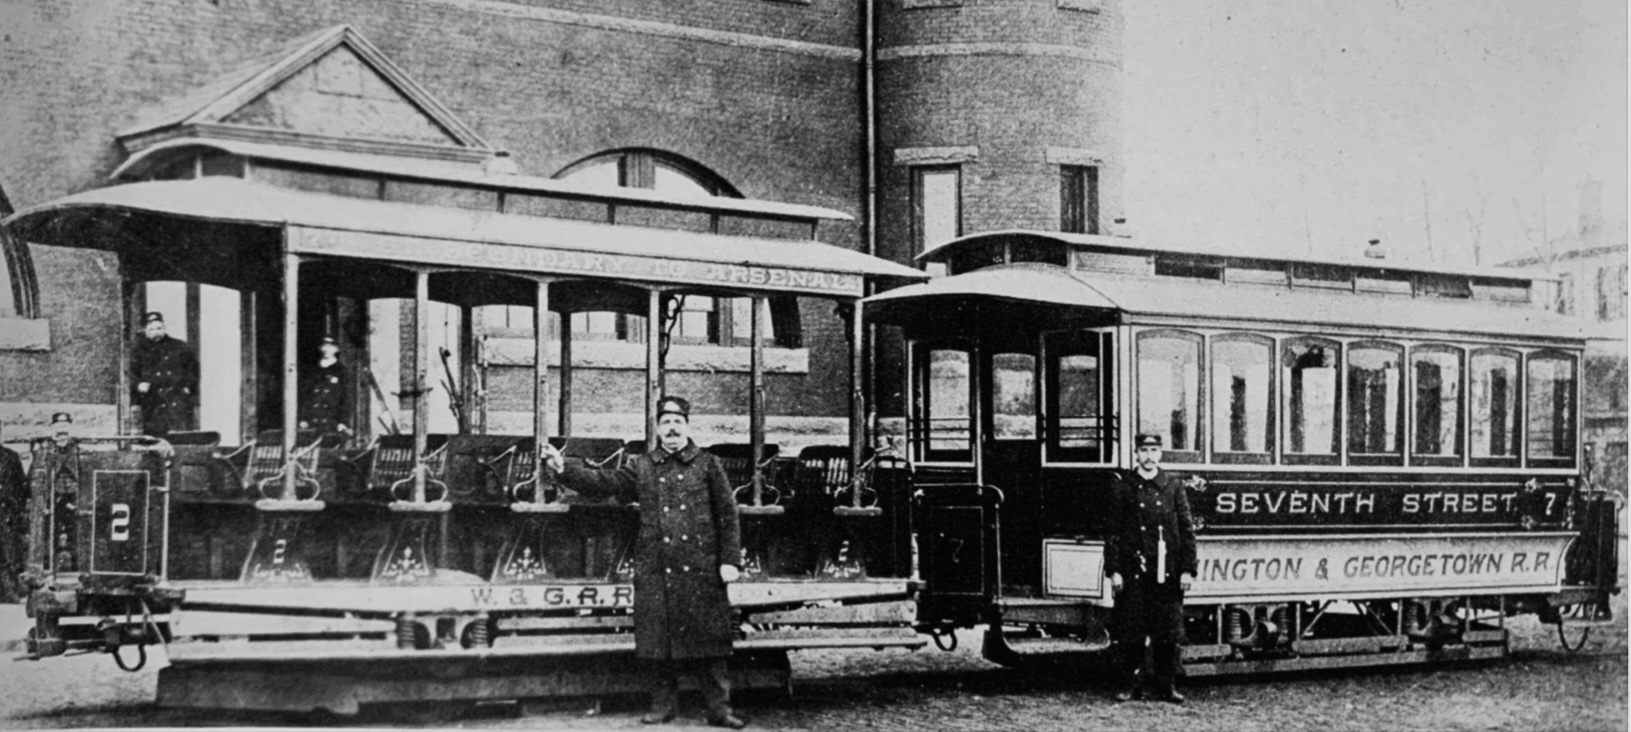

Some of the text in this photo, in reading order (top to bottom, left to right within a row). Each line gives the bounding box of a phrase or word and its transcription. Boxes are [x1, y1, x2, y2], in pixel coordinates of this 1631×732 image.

[706, 265, 848, 288] ARSENAL
[1215, 491, 1375, 513] SEVENTH
[1545, 492, 1557, 515] 7
[111, 503, 130, 541] 2
[273, 539, 287, 564] 2
[838, 540, 850, 562] 2
[1194, 558, 1303, 581] INGTON
[1314, 558, 1329, 581] &
[1343, 553, 1504, 578] GEORGETOWN
